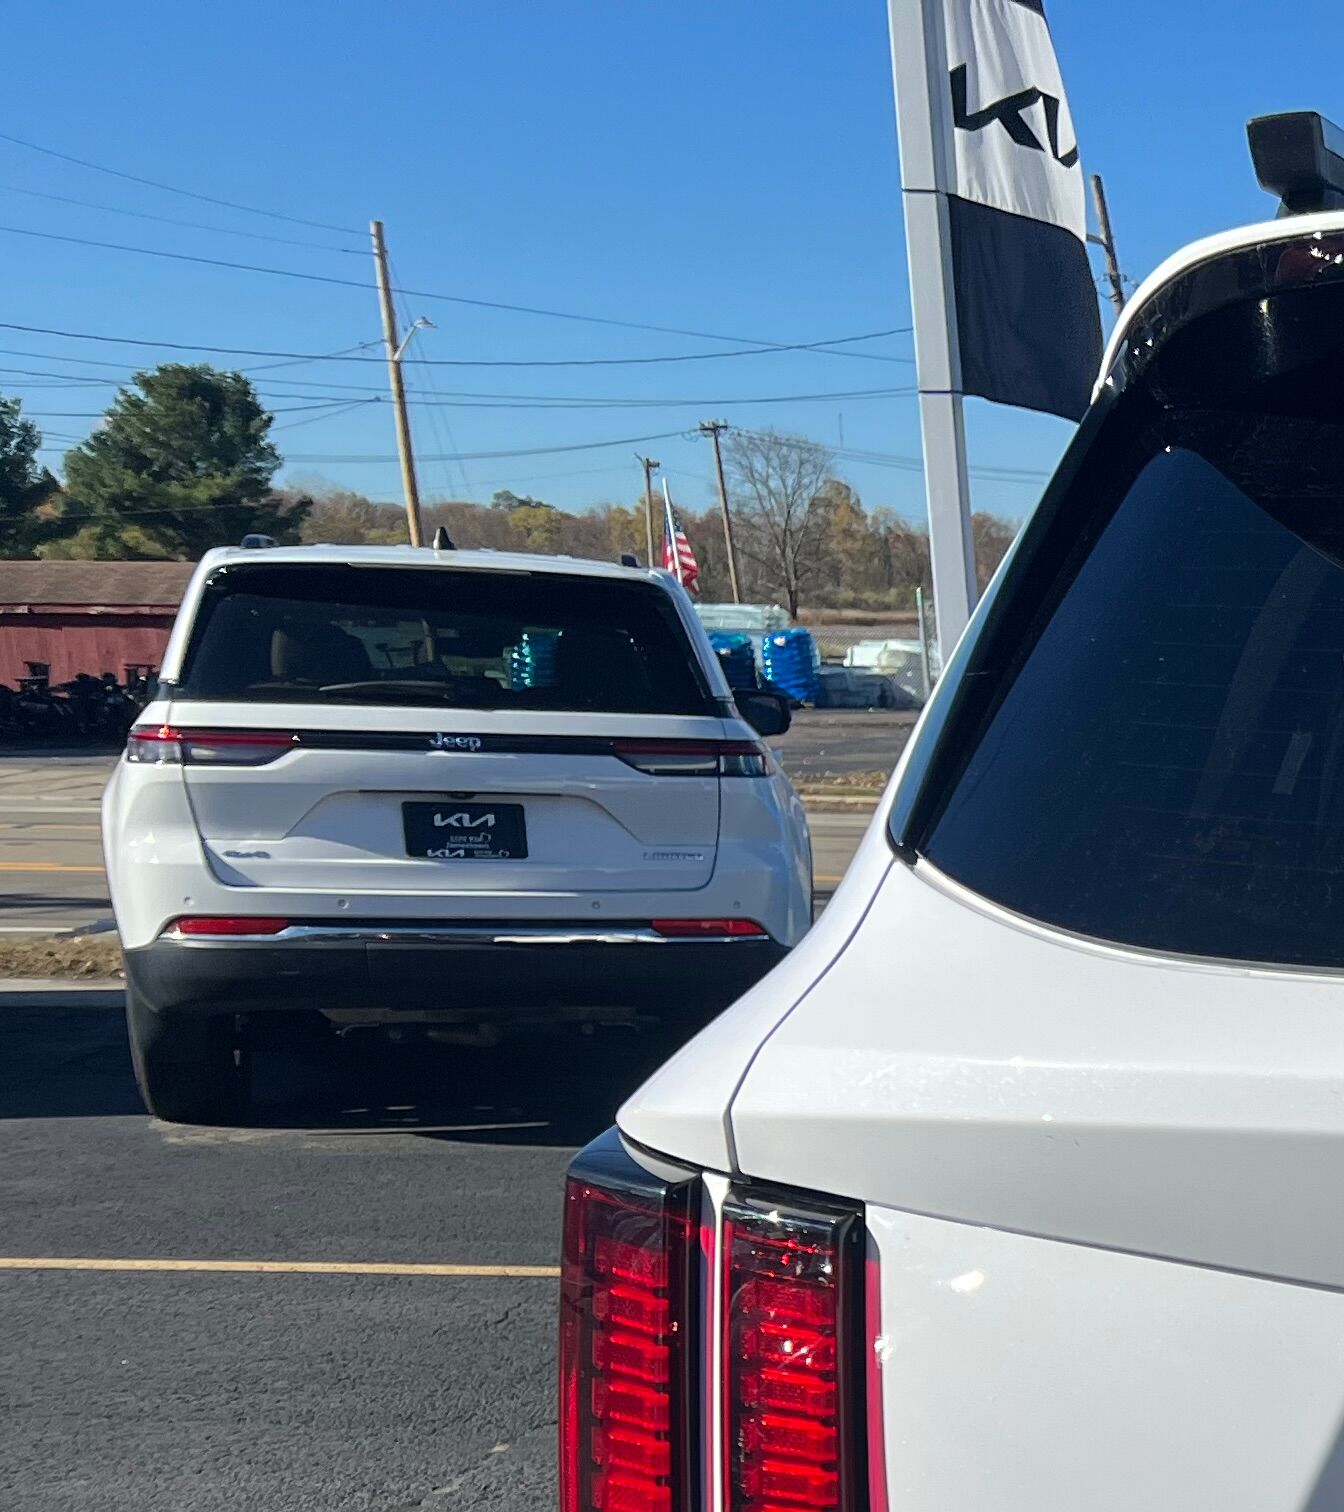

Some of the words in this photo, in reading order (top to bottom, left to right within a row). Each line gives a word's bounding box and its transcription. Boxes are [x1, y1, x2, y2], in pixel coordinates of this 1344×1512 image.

[949, 62, 1078, 168] KI
[429, 732, 481, 751] Jeep
[433, 812, 495, 828] KIA
